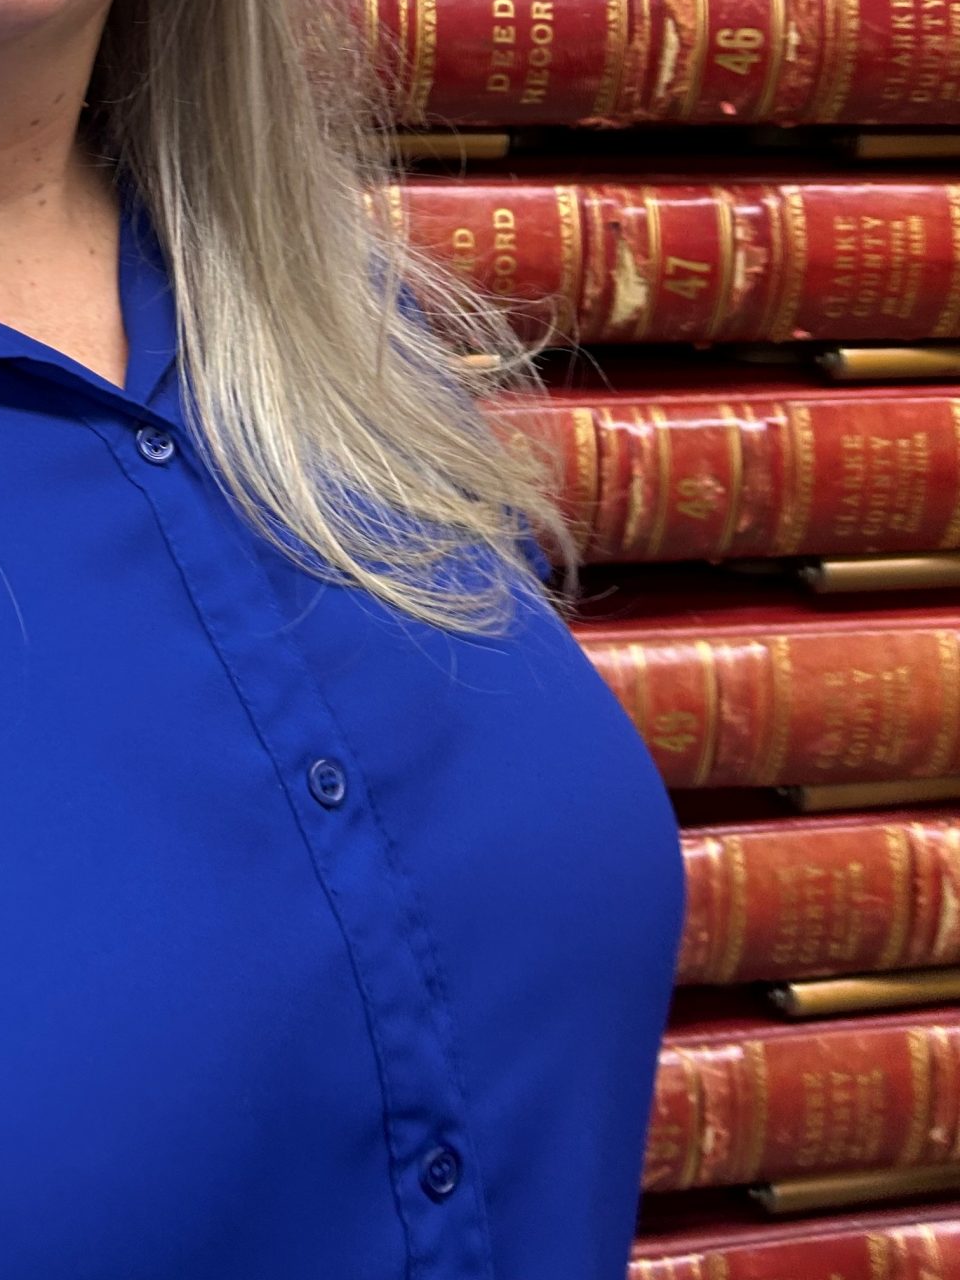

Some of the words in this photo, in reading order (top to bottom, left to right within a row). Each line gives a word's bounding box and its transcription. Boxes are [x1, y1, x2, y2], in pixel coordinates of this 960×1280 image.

[715, 27, 763, 75] 46
[492, 208, 517, 295] CORD
[666, 255, 711, 298] 47
